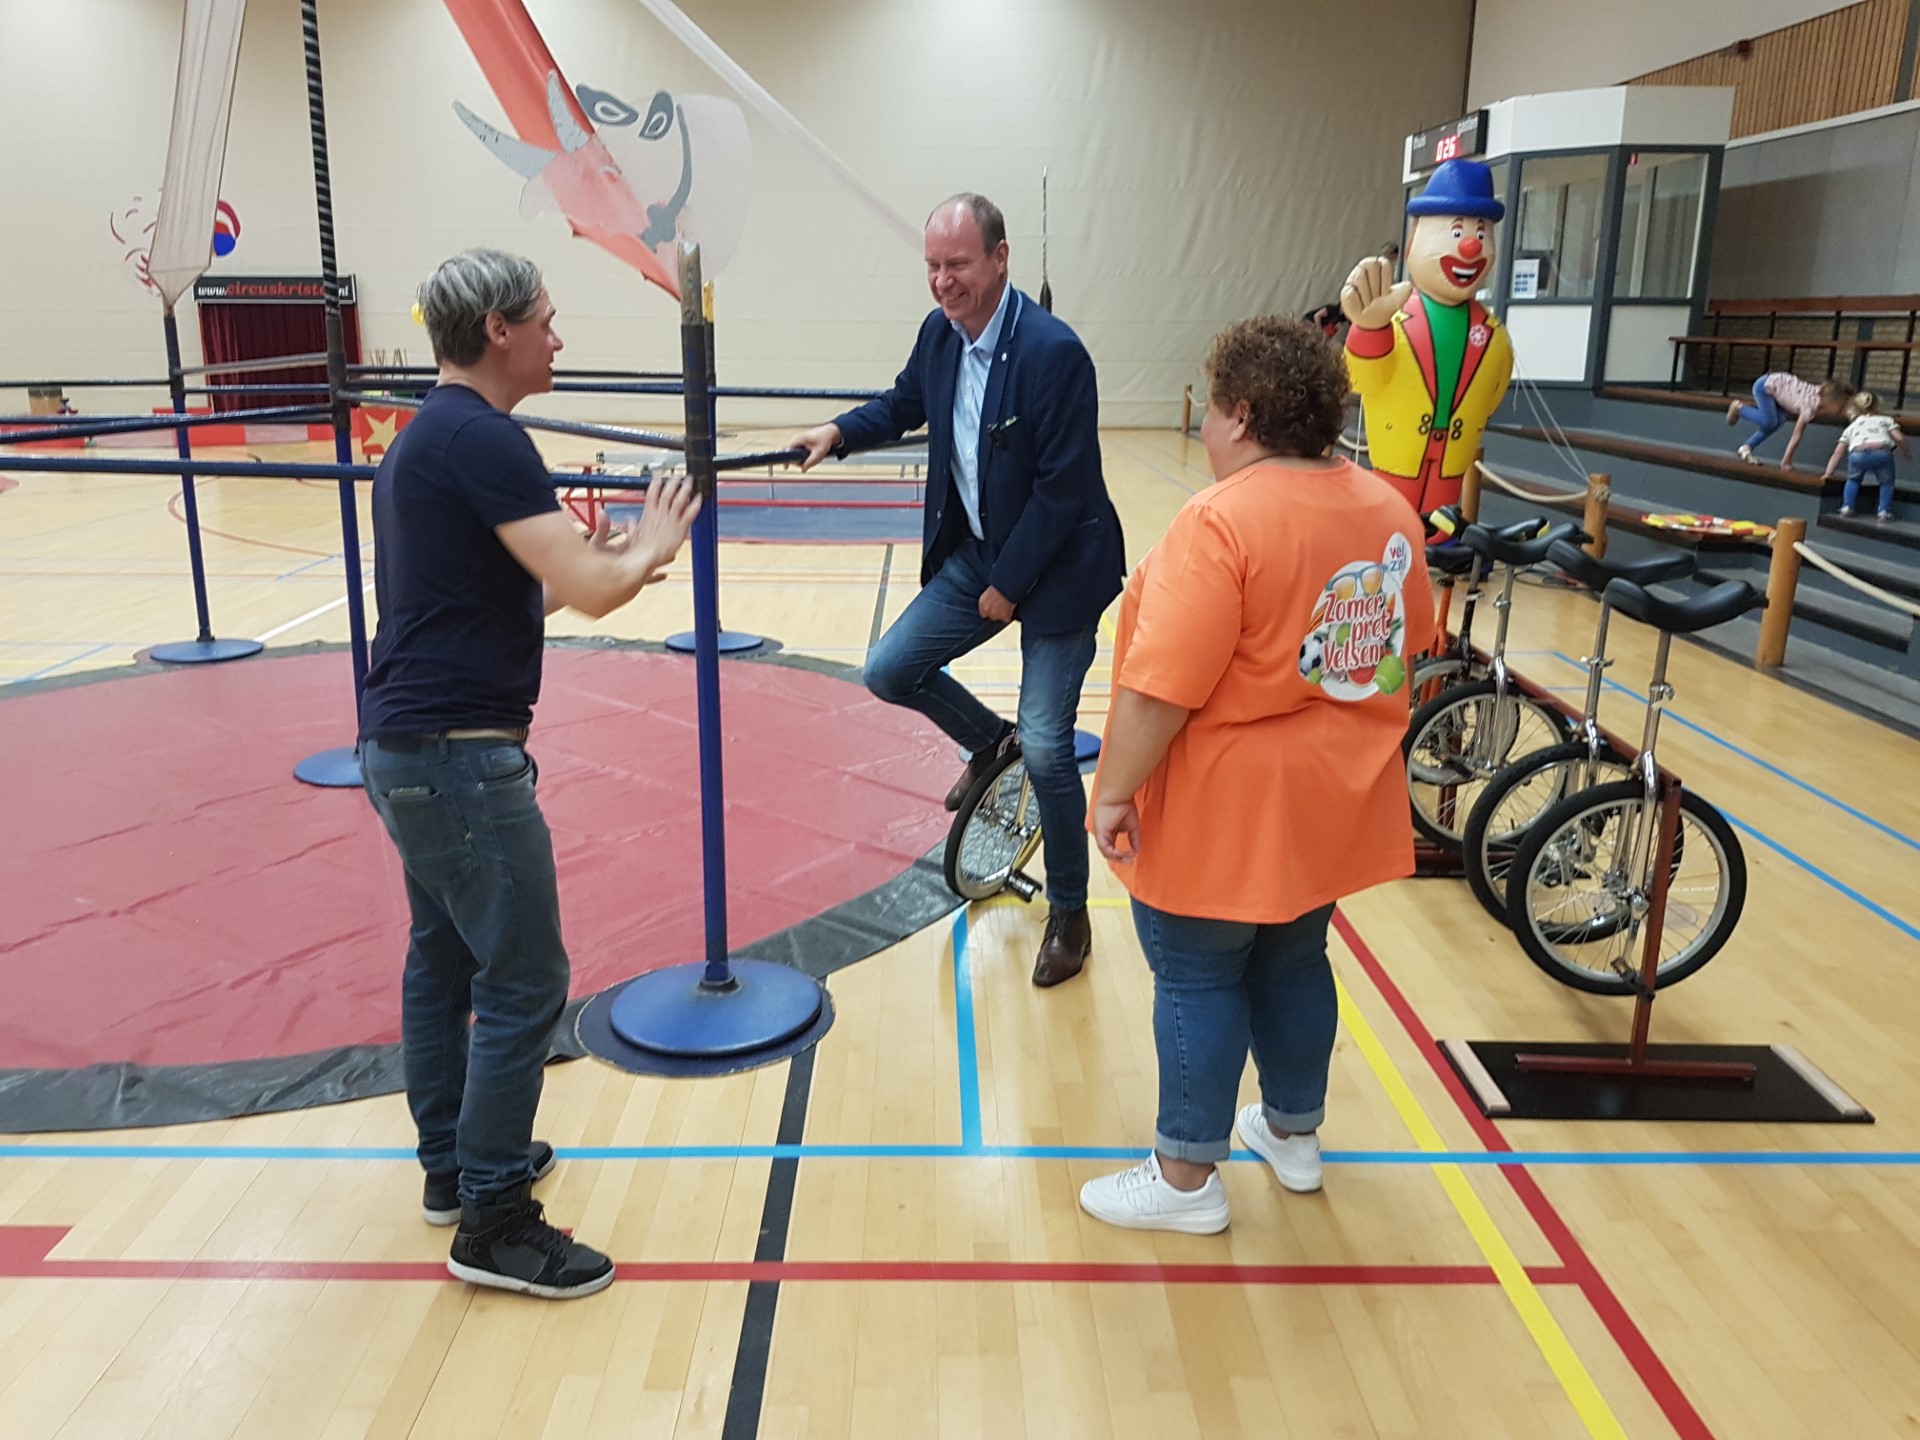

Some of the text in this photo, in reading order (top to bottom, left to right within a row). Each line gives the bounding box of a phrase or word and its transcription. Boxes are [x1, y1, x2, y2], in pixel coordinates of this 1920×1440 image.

[1324, 593, 1384, 623] Zomer
[1352, 611, 1389, 645] pret
[1323, 640, 1381, 671] Velsen
